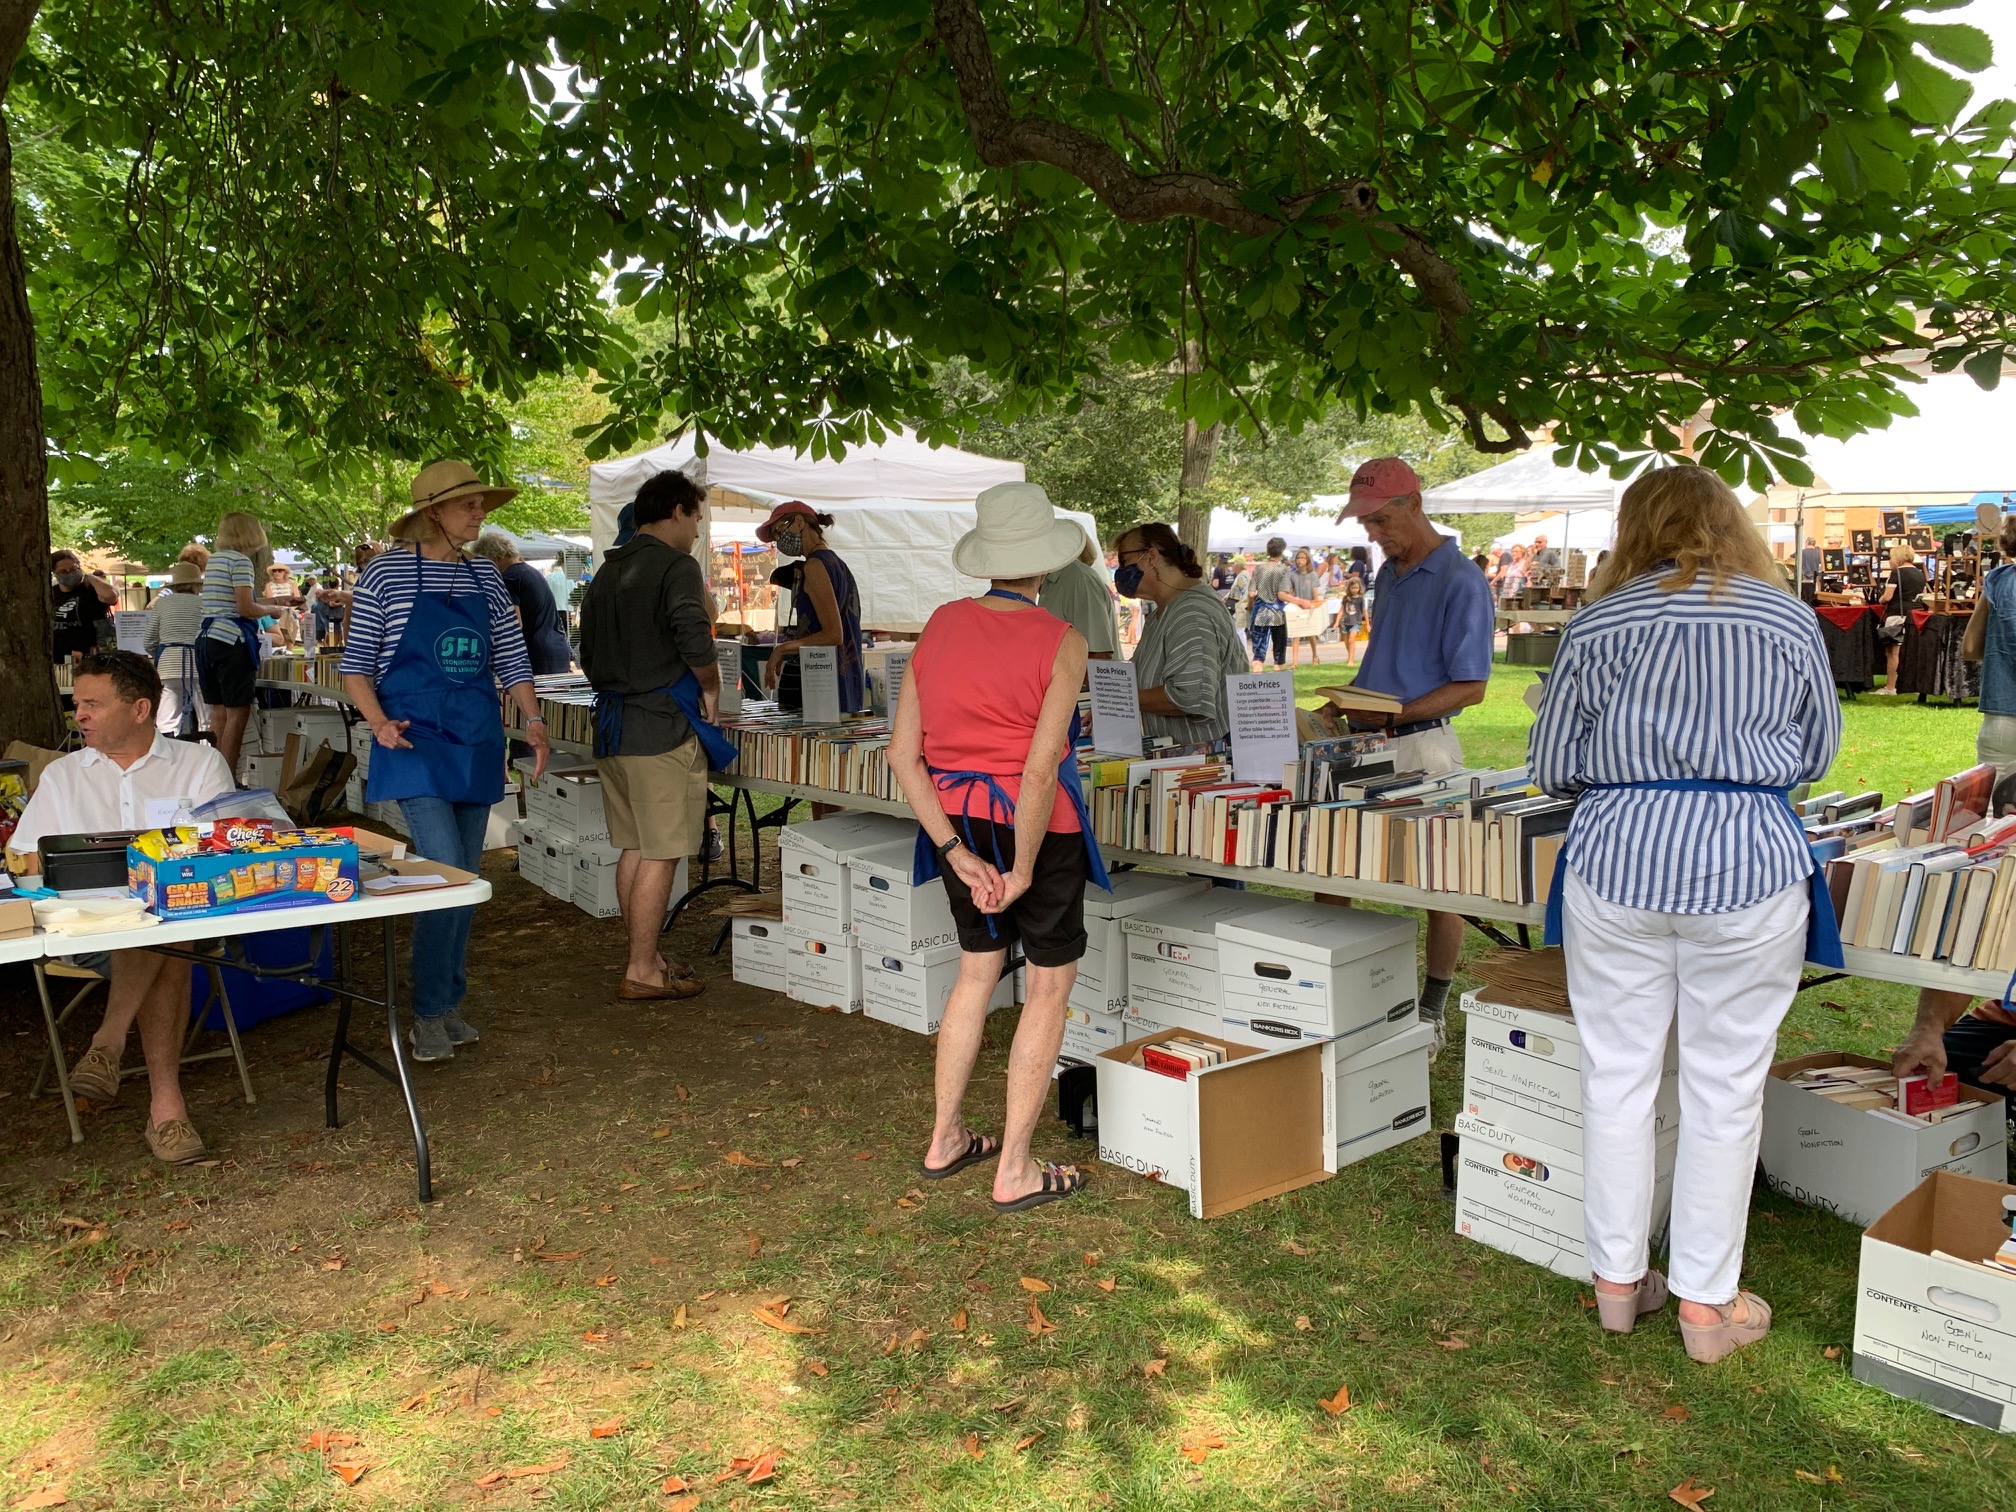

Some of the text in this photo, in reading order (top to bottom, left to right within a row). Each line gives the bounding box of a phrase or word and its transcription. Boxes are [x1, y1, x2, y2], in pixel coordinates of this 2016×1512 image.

[1239, 681, 1280, 690] Book Prices
[227, 827, 265, 841] Cheez
[578, 833, 604, 843] BASIC
[167, 882, 208, 894] GRAB
[328, 880, 353, 893] 22
[167, 895, 209, 907] SNACK
[599, 908, 621, 916] BASI
[784, 925, 810, 937] BASIC DUTY
[1124, 922, 1164, 935] BASIC DUTY
[911, 936, 940, 951] BASIC
[1107, 996, 1127, 1011] BAS
[1463, 999, 1519, 1021] BASIC DUTY
[1141, 1017, 1161, 1031] DUTY
[1253, 1023, 1284, 1034] BANKERS
[1471, 1038, 1505, 1055] CONTENTS:
[1458, 1119, 1516, 1145] BASIC DUTY
[1800, 1139, 1843, 1149] NONFICTION
[1100, 1146, 1170, 1181] BASIC DUTY
[1464, 1160, 1500, 1178] CONTENTS:
[1504, 1180, 1541, 1200] GENERAL
[1767, 1174, 1839, 1212] SIC DUTY
[1866, 1290, 1920, 1314] CONTENTS:
